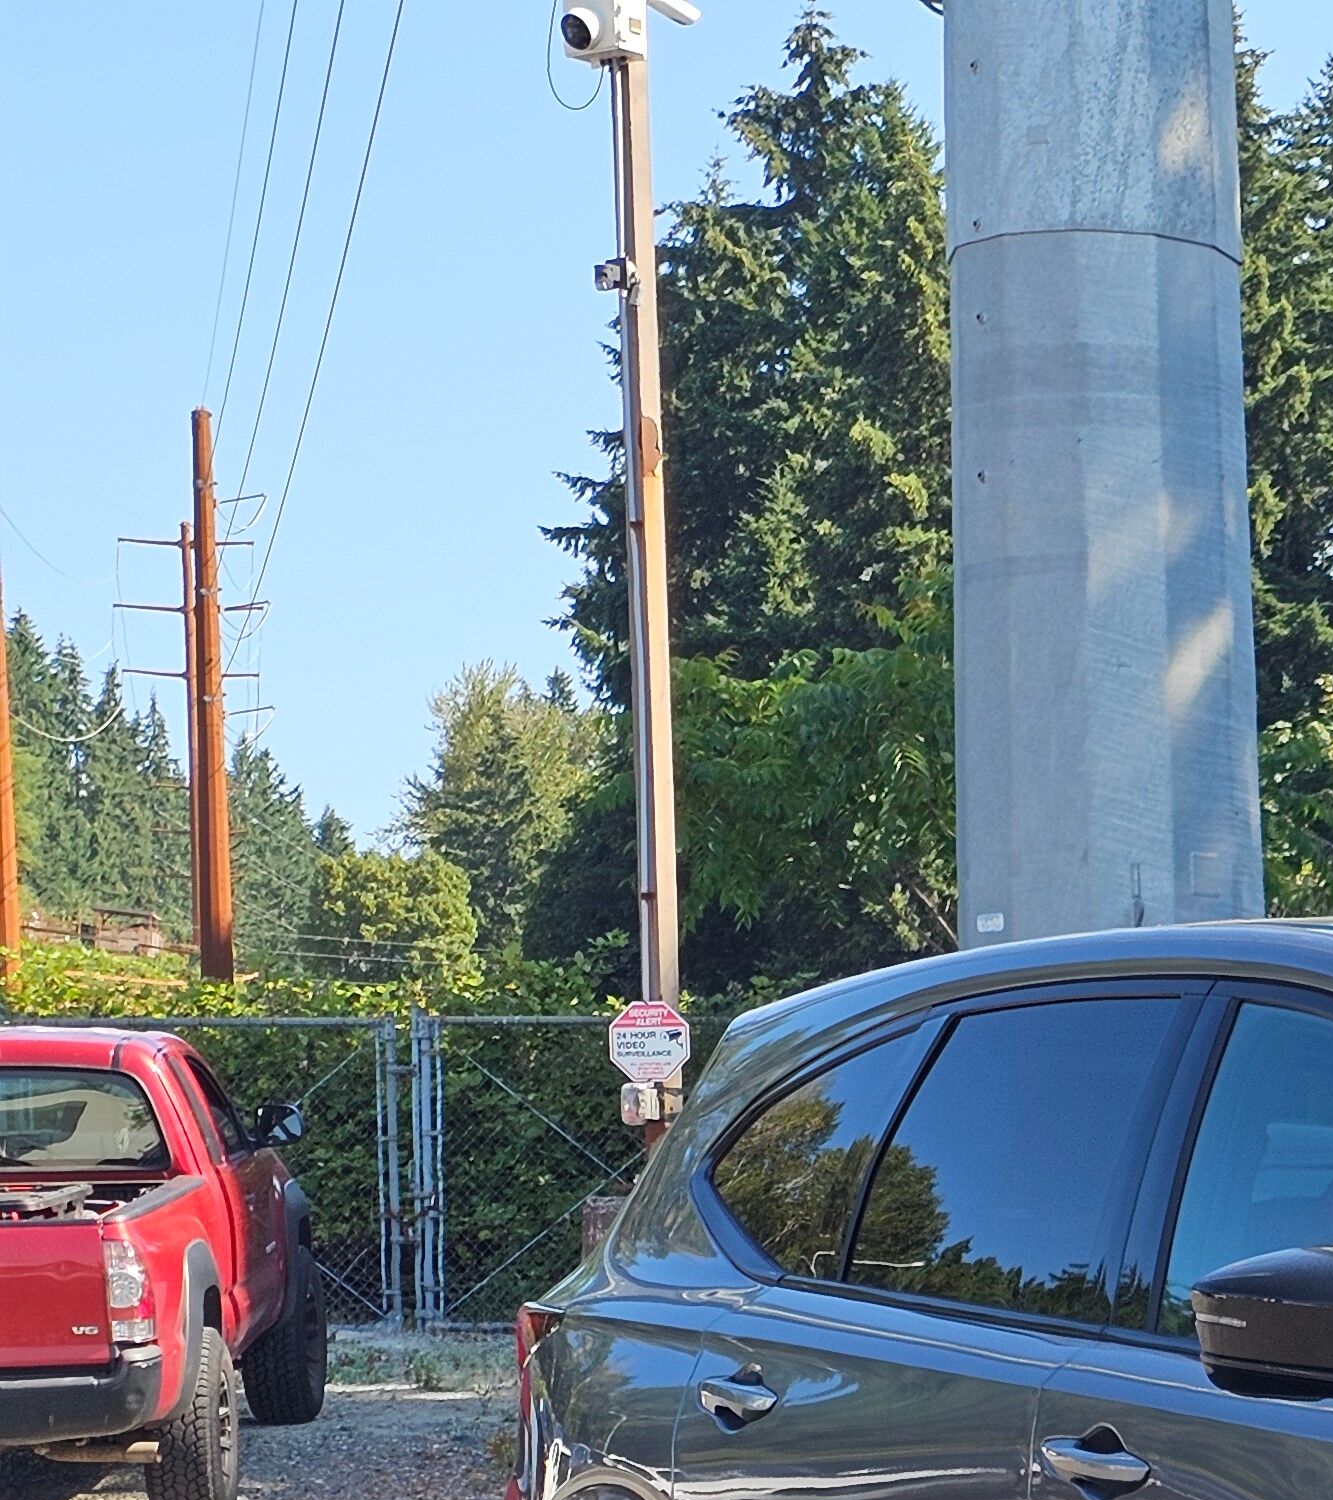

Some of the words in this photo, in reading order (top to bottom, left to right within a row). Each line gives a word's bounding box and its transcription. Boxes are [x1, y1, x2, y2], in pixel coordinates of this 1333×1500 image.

[628, 1008, 668, 1018] SECURITY
[635, 1017, 662, 1026] ALERT
[616, 1032, 627, 1040] 24
[630, 1031, 656, 1040] HOUR
[616, 1041, 646, 1050] VIDEO
[616, 1050, 672, 1058] SURVEILLANCE
[71, 1326, 99, 1335] V6
